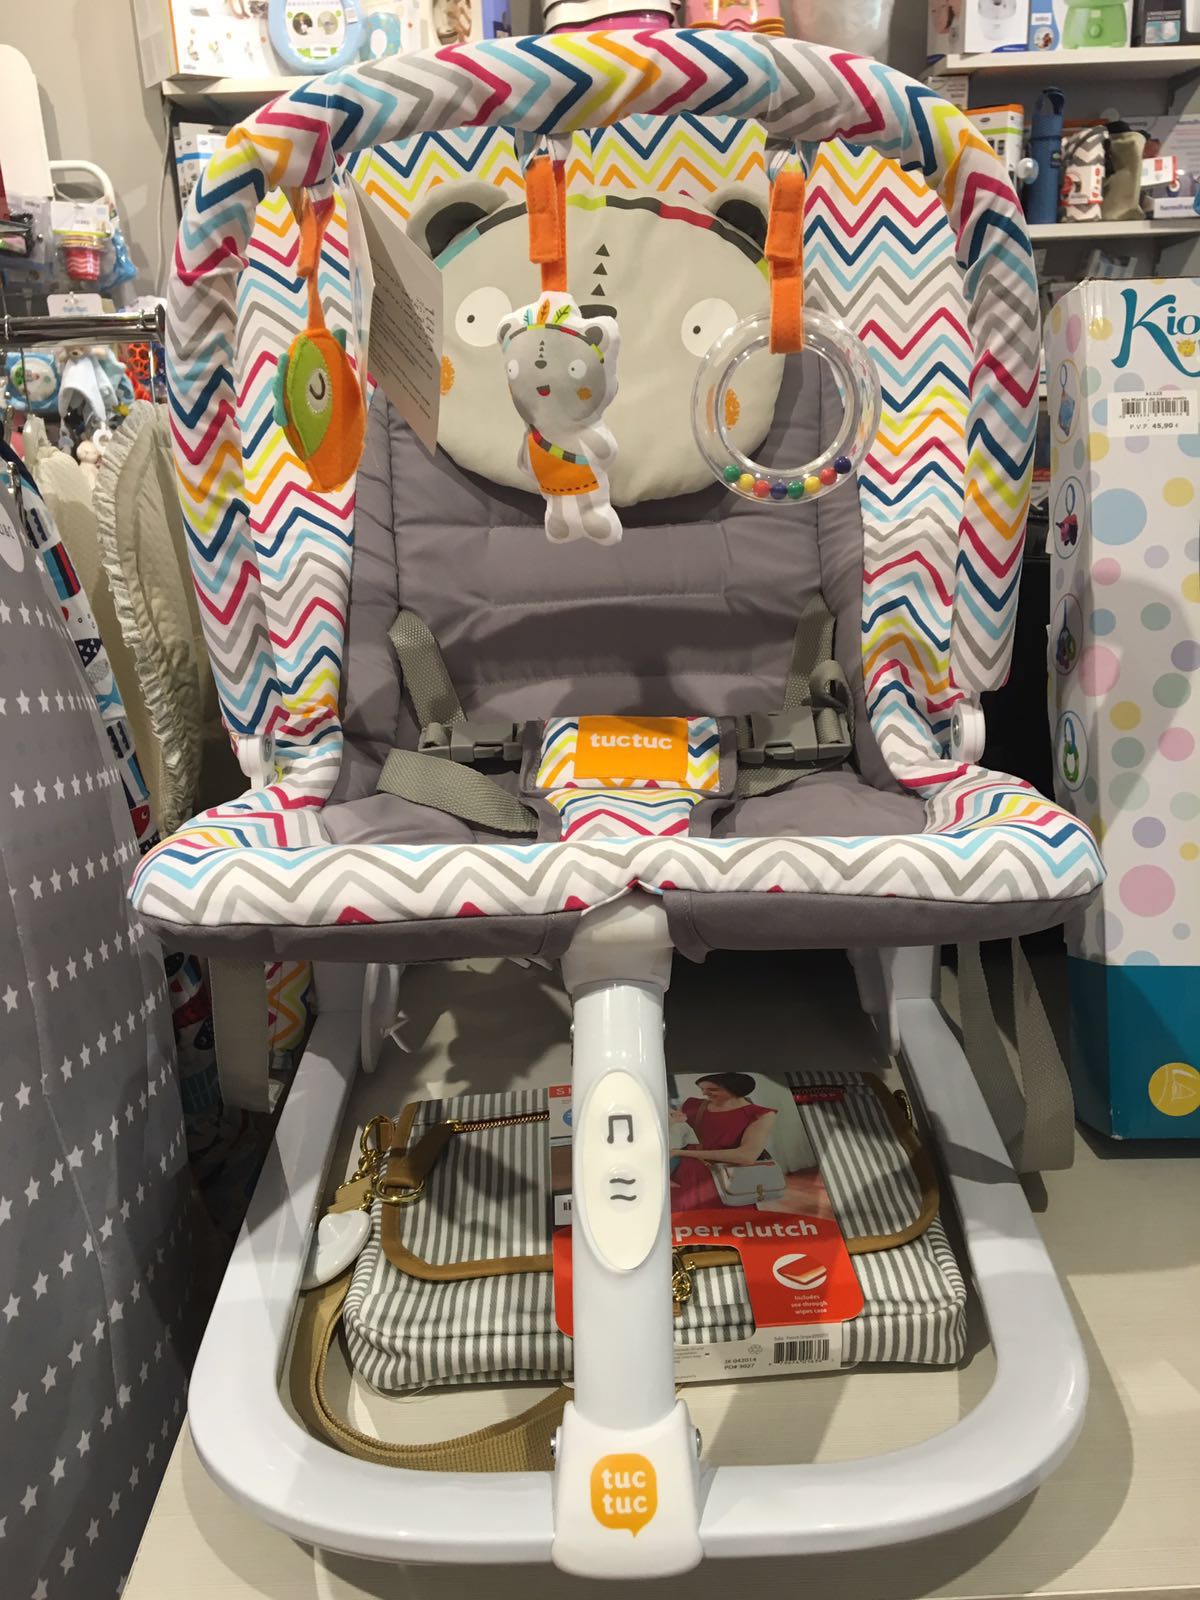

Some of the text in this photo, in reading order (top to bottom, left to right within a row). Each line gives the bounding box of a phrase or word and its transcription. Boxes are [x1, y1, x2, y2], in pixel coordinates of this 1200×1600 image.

[673, 1220, 818, 1242] per clutch
[601, 1469, 646, 1490] tuc
[602, 1493, 648, 1515] tuc
